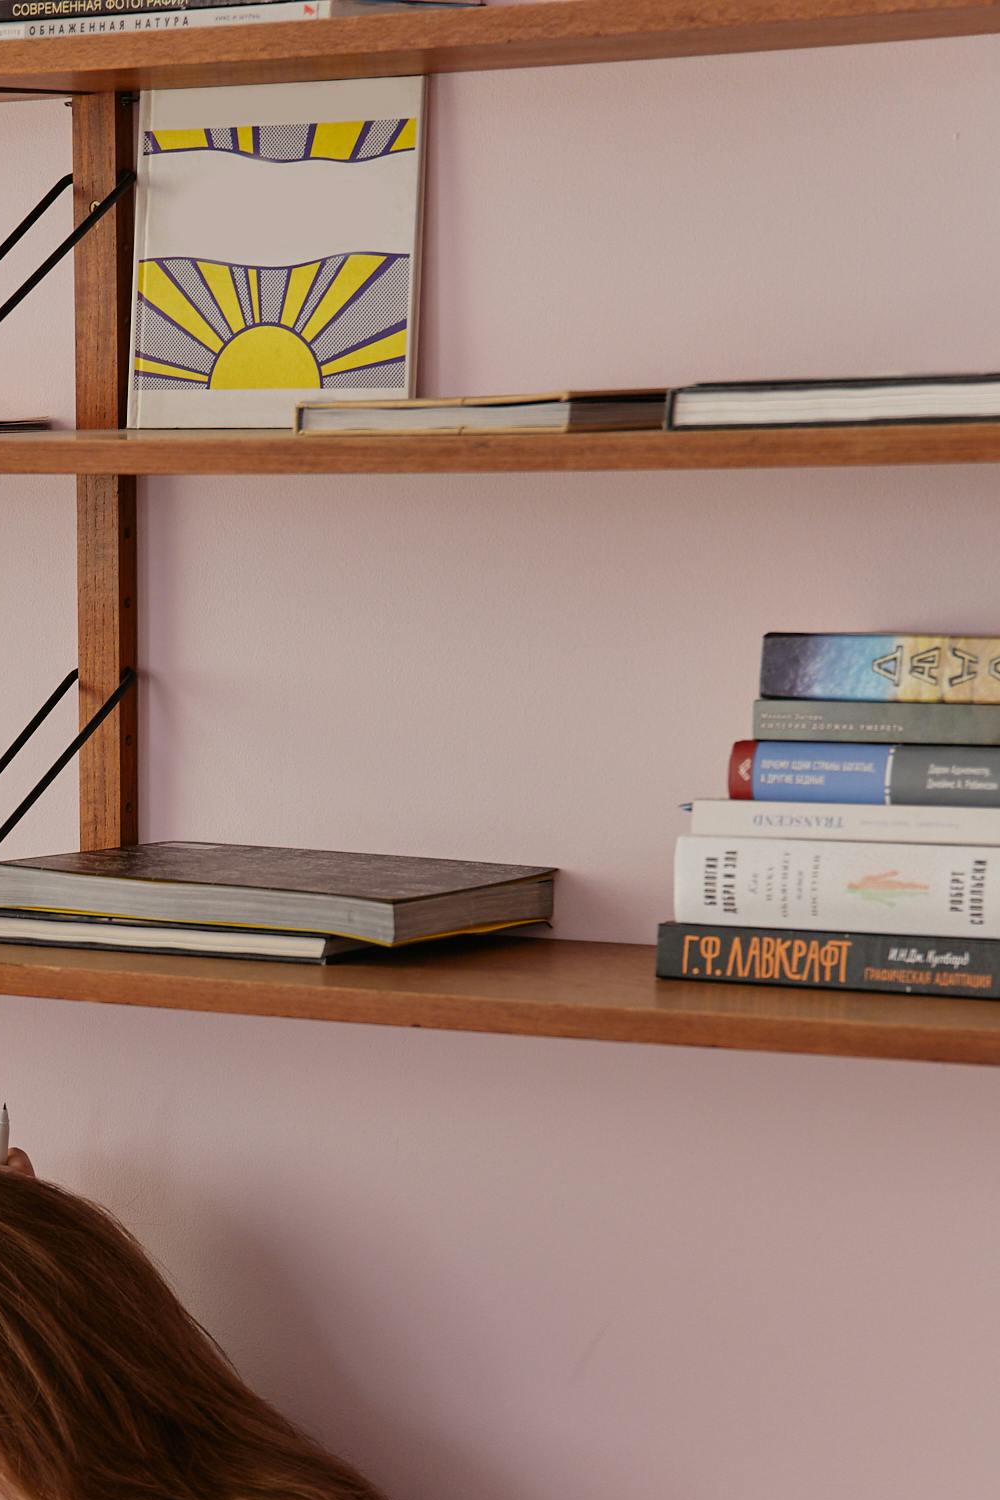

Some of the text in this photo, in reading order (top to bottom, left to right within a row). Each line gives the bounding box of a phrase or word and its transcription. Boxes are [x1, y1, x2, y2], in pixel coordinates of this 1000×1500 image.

[12, 0, 102, 16] СОВРЕМЕННАЯ
[29, 16, 189, 36] ОБНАЖЕННАЯ НАТУРА
[753, 814, 844, 829] TRANSCEND
[723, 850, 738, 869] ЗЛА
[704, 857, 718, 906] БИОЛОГИЯ
[949, 871, 965, 912] РОБЕРТ
[969, 860, 987, 925] САПОЛЬСКИ
[722, 884, 738, 914] ДОБРА
[682, 935, 853, 983] Г.Ф. ЛАВКРАФТ
